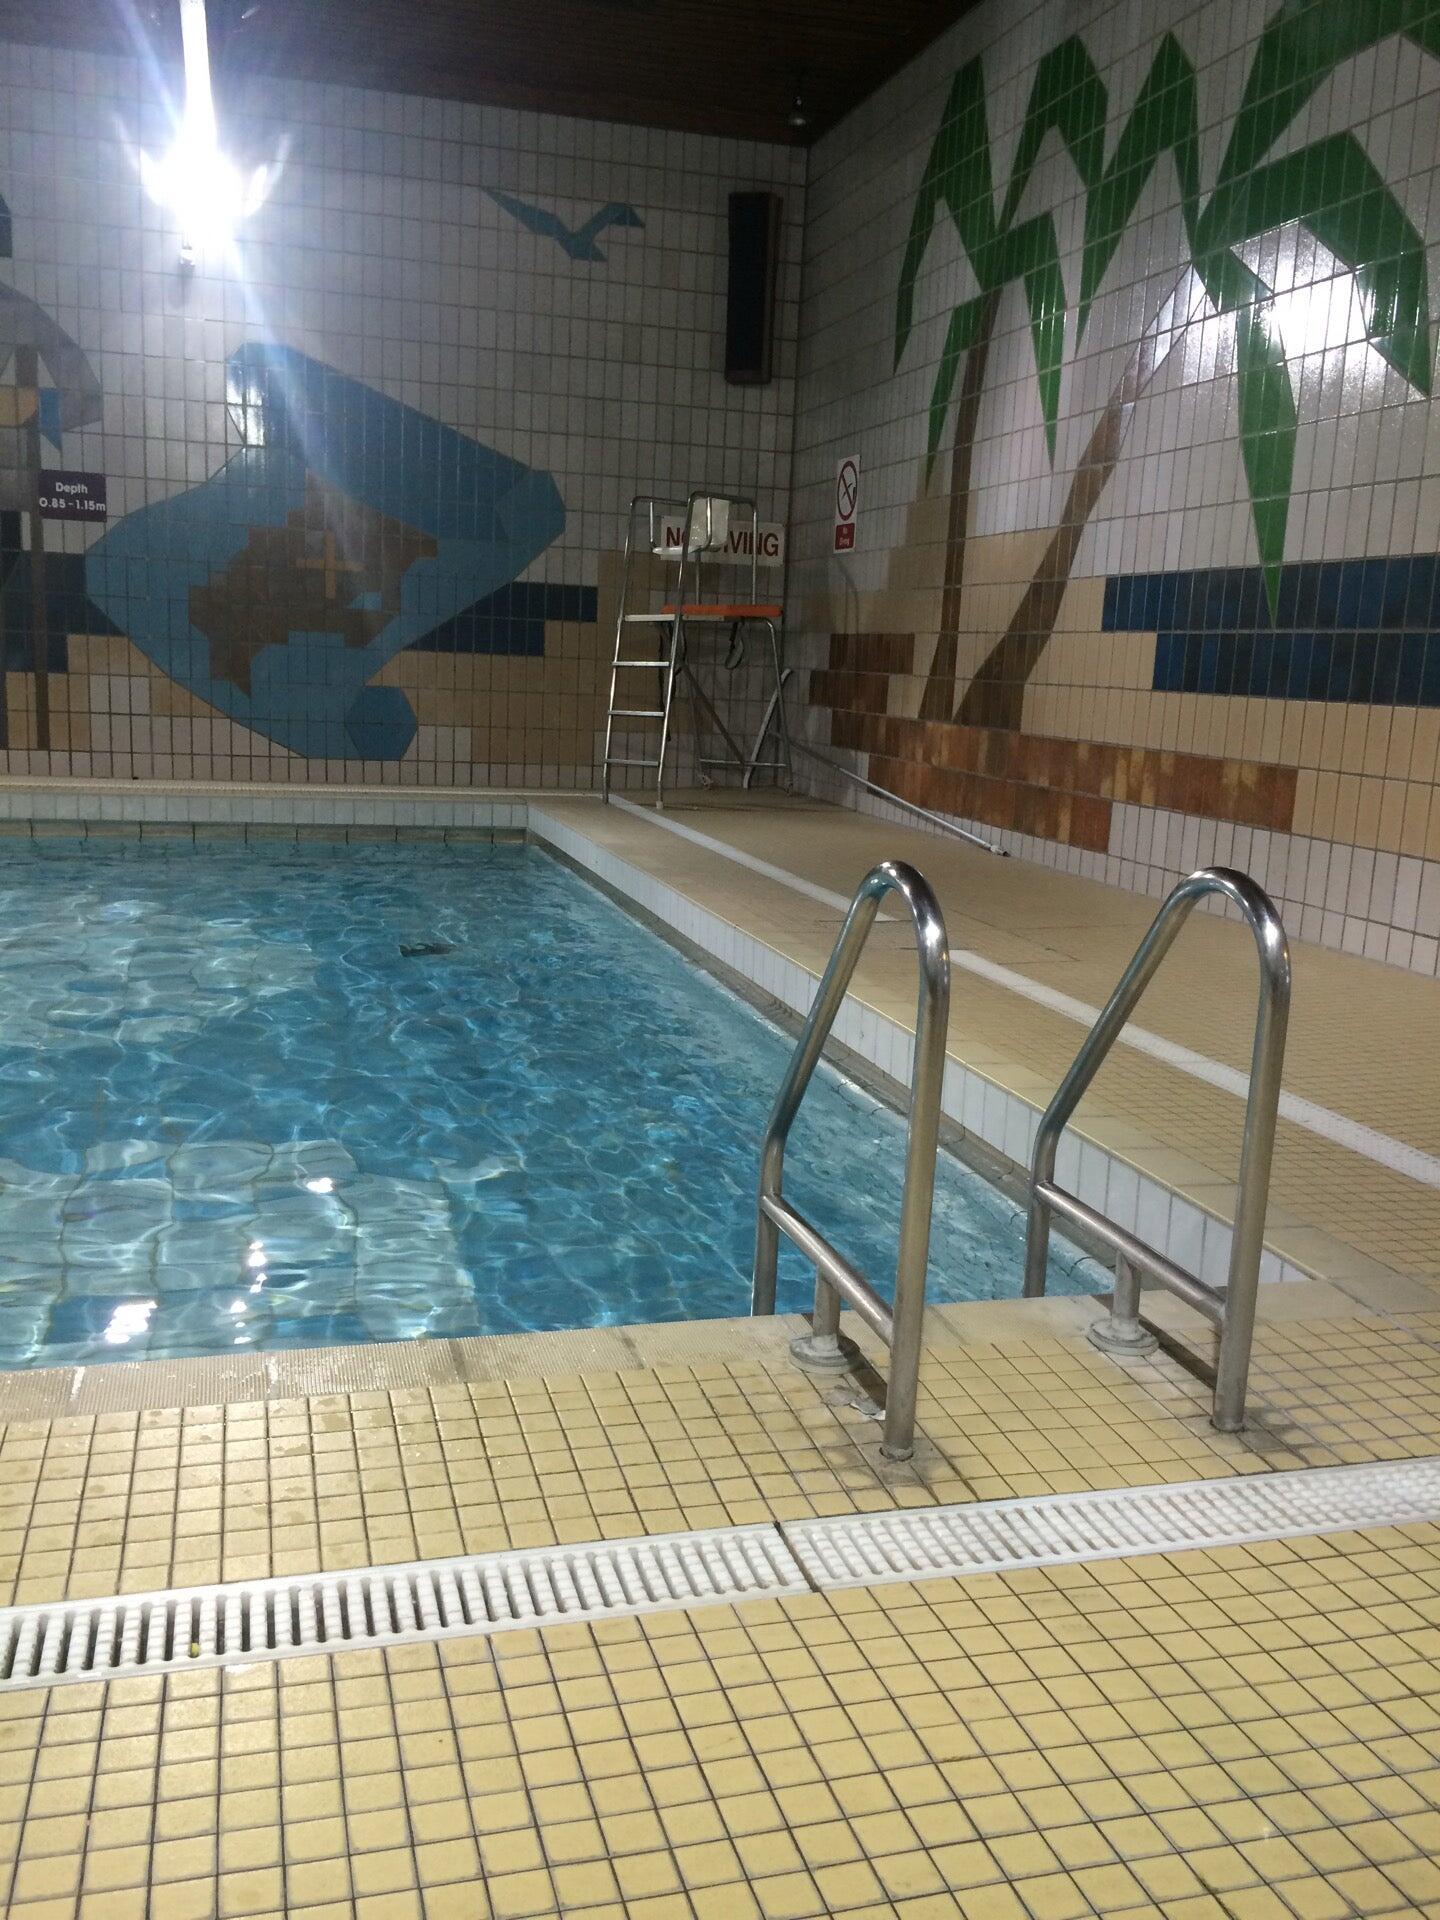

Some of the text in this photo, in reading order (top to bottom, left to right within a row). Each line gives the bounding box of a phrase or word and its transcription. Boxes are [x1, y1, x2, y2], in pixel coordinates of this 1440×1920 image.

[55, 482, 88, 495] Depth
[666, 526, 779, 557] N VING
